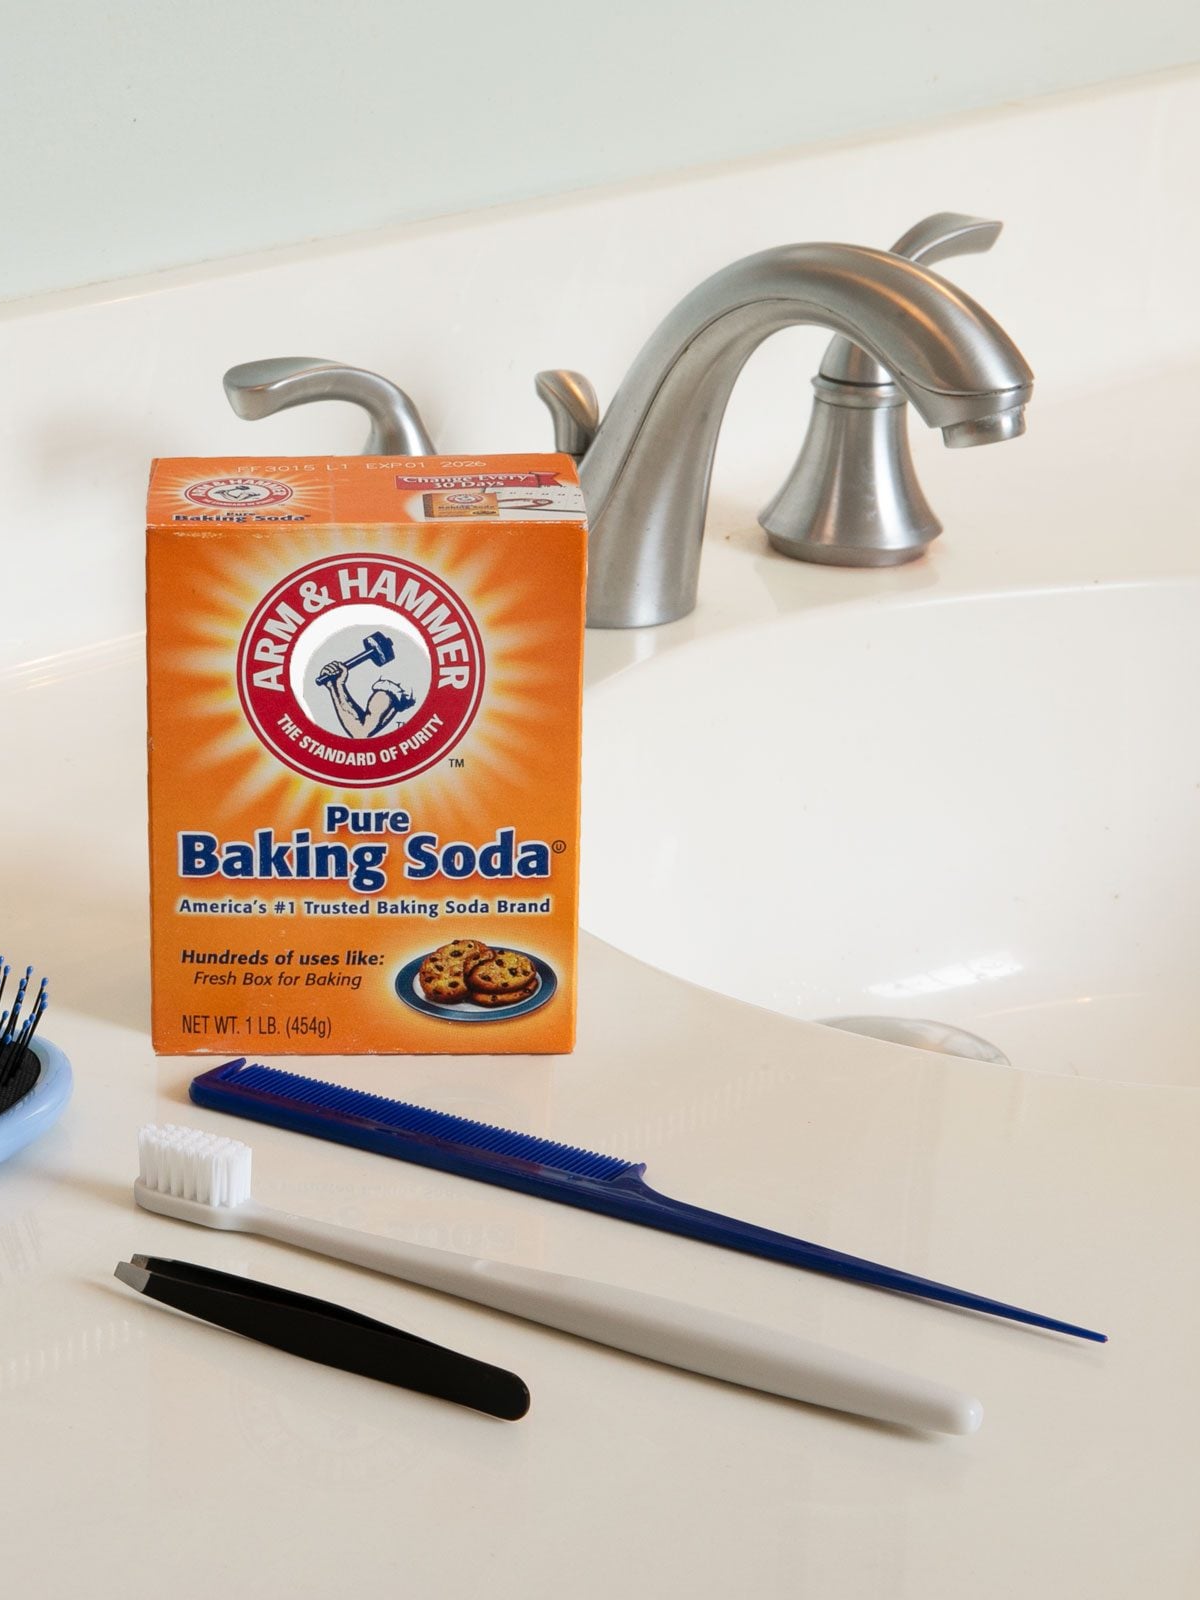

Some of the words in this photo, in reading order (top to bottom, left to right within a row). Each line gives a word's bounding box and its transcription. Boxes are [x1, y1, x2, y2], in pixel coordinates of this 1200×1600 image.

[441, 460, 487, 468] 2026
[433, 480, 456, 488] 30
[460, 480, 505, 488] Days
[478, 473, 528, 482] Every
[174, 514, 249, 524] Baking
[254, 513, 306, 522] Soda
[253, 601, 306, 692] ARM
[299, 580, 336, 613] &
[337, 567, 470, 691] HAMMER
[277, 713, 301, 742] THE
[299, 735, 377, 767] STANDARD
[380, 746, 399, 764] OF
[399, 713, 445, 756] PURITY
[326, 804, 411, 834] Pure
[178, 828, 388, 894] Baking
[404, 827, 552, 879] Soda
[179, 899, 267, 915] America's
[273, 900, 295, 914] #1
[304, 900, 370, 915] Trusted
[377, 900, 439, 918] Baking
[445, 899, 490, 915] Soda
[497, 898, 551, 914] Brand
[180, 949, 269, 966] Hundreds
[274, 949, 295, 966] of
[299, 953, 340, 966] uses
[345, 950, 385, 966] like:
[193, 970, 237, 987] Fresh
[242, 971, 273, 987] Box
[277, 970, 300, 987] for
[304, 970, 362, 990] Baking
[181, 1014, 209, 1035] NET
[213, 1015, 241, 1035] WT.
[245, 1016, 252, 1035] 1
[258, 1015, 280, 1035] LB.
[285, 1015, 332, 1038] (454g)
